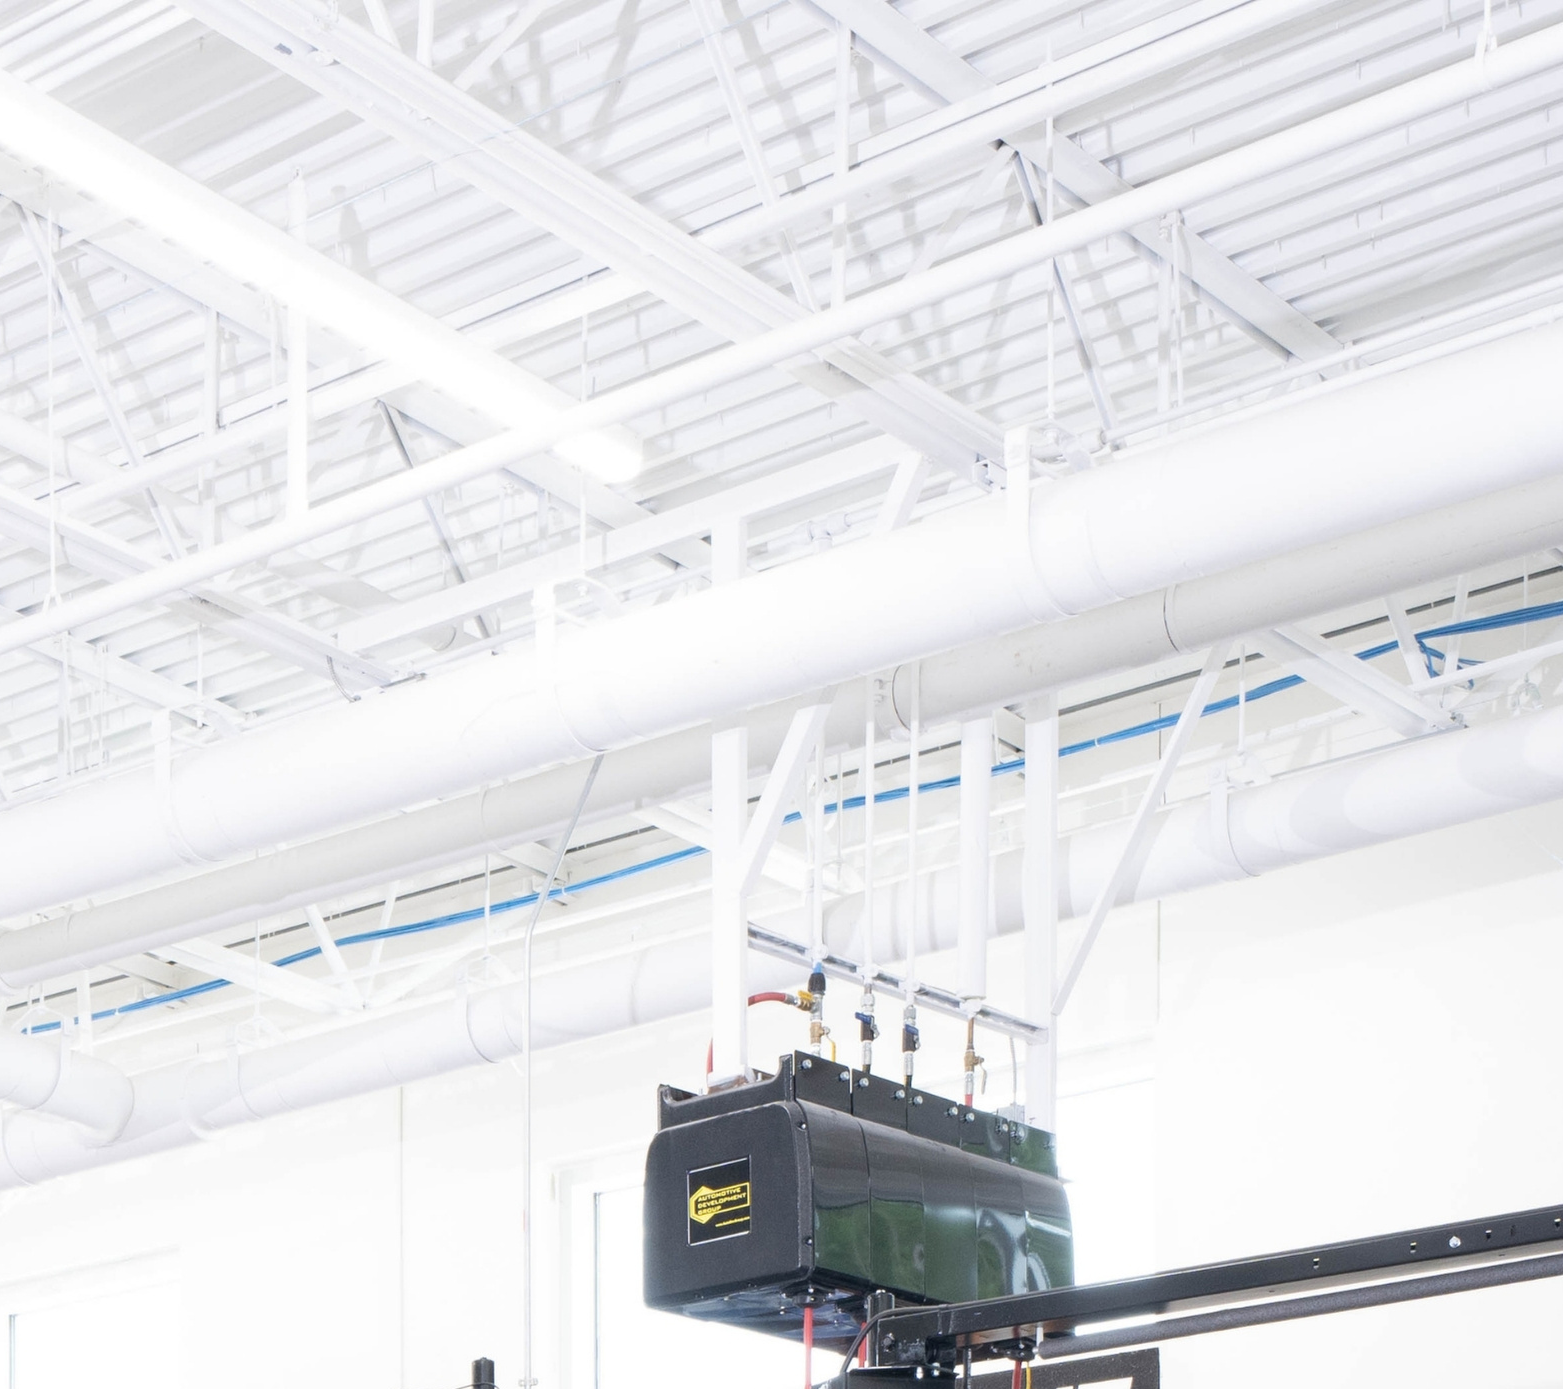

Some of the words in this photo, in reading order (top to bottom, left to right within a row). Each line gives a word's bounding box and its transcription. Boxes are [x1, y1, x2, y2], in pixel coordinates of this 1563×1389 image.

[698, 1187, 741, 1202] AUTOMOTIVE
[698, 1192, 747, 1209] DEVELOPMENT
[698, 1205, 721, 1215] GROUP
